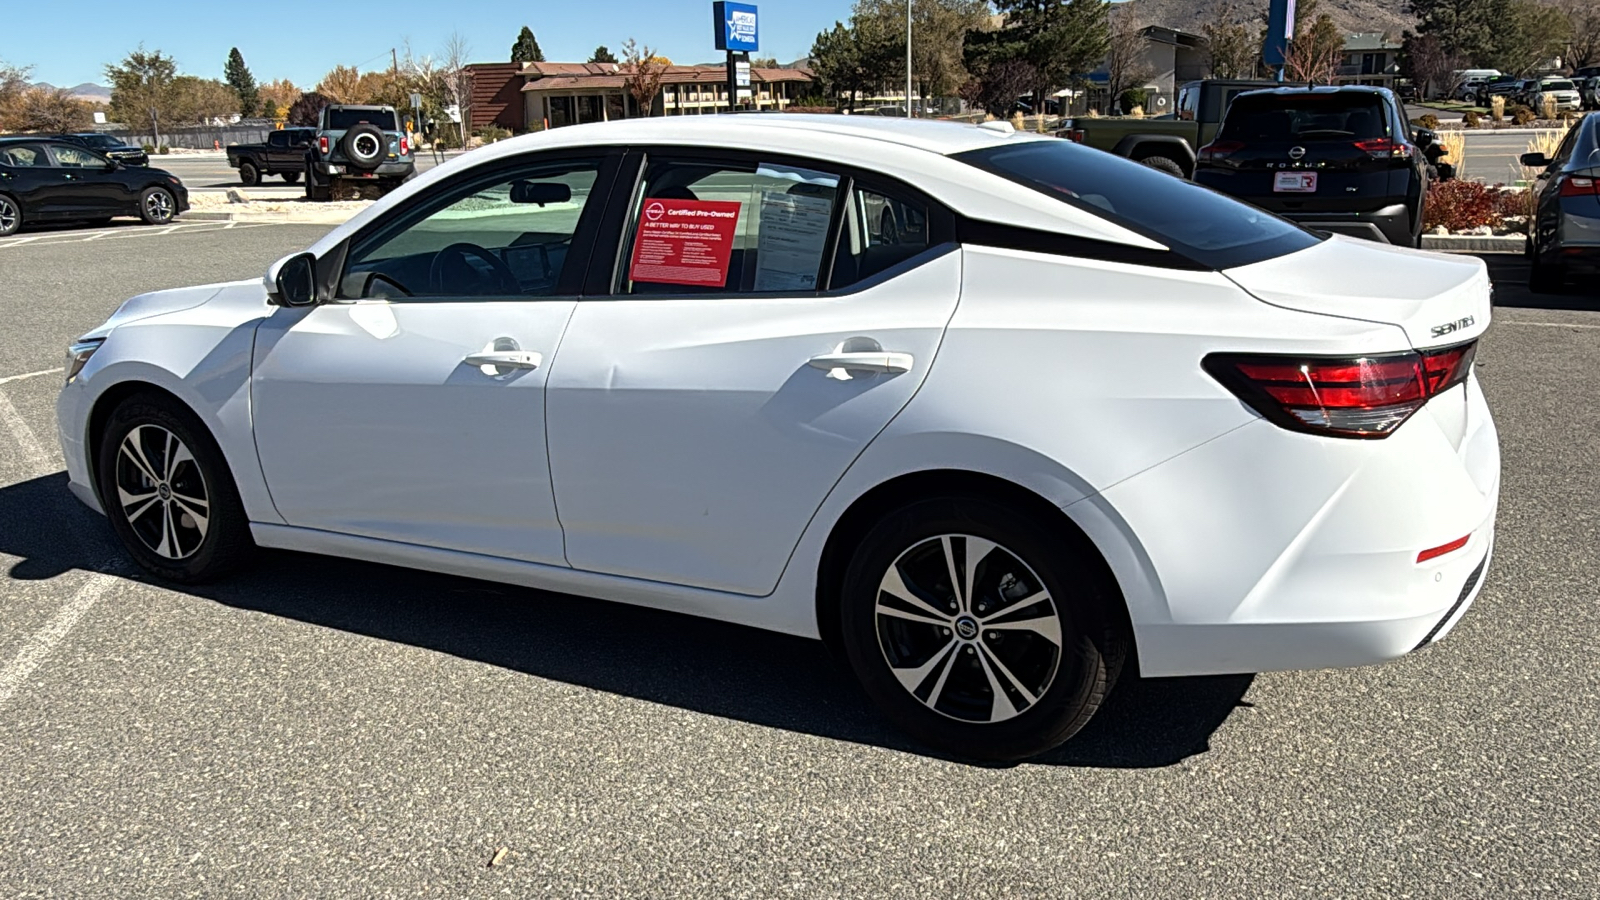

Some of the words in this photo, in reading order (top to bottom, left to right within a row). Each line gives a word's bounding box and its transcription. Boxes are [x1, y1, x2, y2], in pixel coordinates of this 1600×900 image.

[667, 209, 696, 217] Certified
[696, 210, 735, 218] Pre-Owned
[1430, 314, 1475, 338] SENTRA
